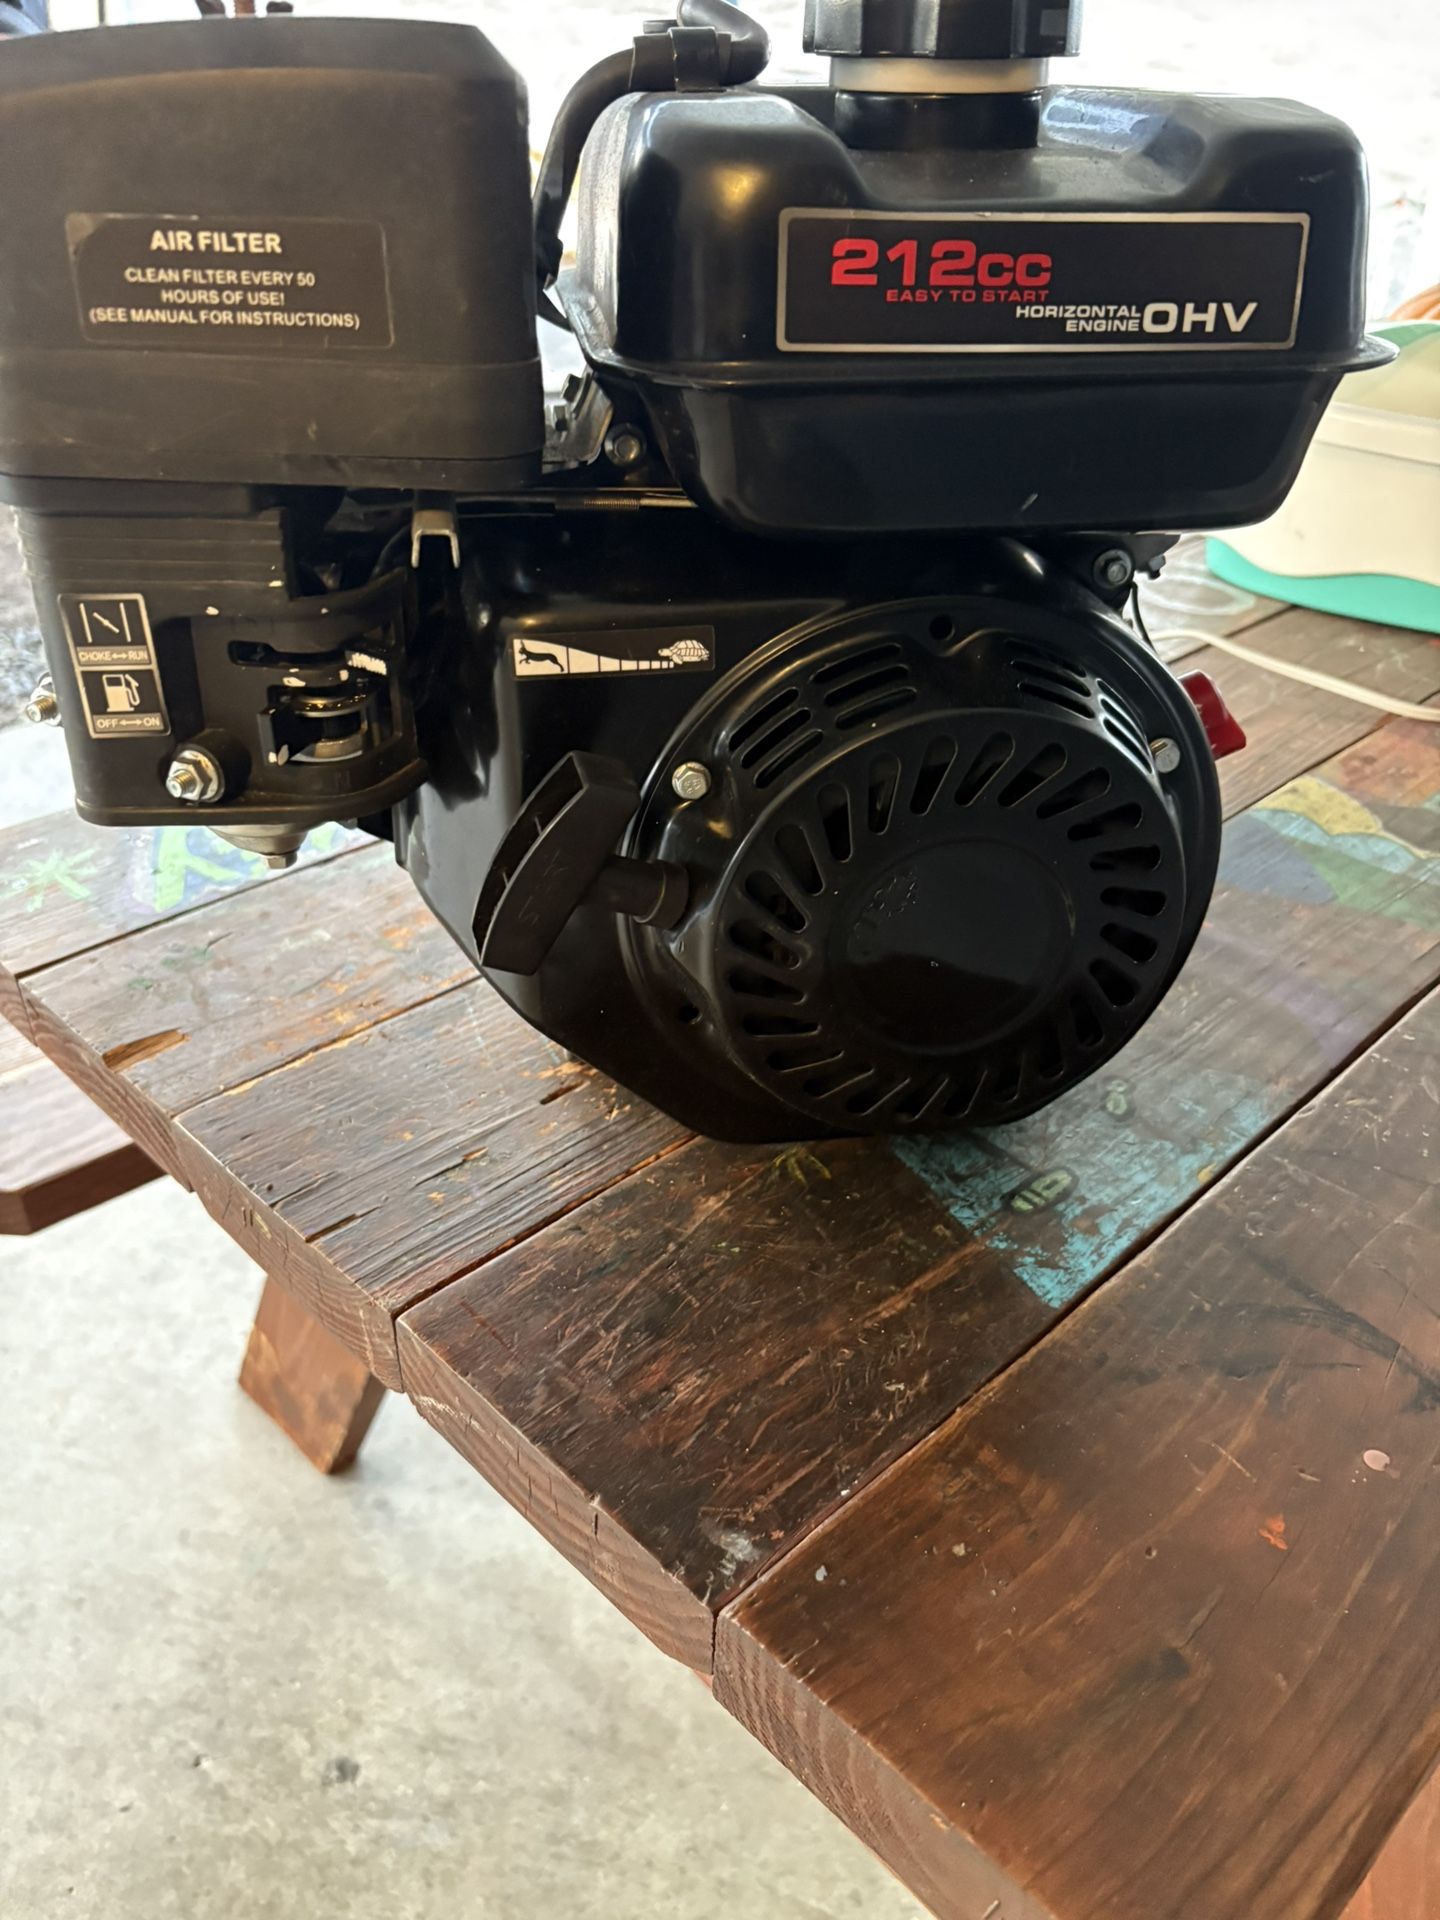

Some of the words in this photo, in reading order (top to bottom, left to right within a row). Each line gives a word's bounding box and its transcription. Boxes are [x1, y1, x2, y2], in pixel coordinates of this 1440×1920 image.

[151, 230, 193, 251] AIR
[198, 232, 282, 253] FILTER
[831, 238, 1052, 286] 212cc
[124, 267, 180, 284] CLEAN
[182, 269, 238, 285] FILTER
[241, 271, 293, 286] EVERY
[297, 272, 315, 286] 50
[161, 290, 220, 304] HOURS
[222, 291, 243, 305] OF
[248, 292, 285, 306] USE!
[886, 289, 942, 302] EASY
[949, 290, 977, 302] TO
[983, 290, 1049, 303] START
[89, 307, 127, 323] (SEE
[131, 308, 197, 324] MANUAL
[200, 310, 233, 325] FOR
[236, 311, 360, 330] INSTRUCTIONS)
[1016, 304, 1141, 318] HORIZONTAL
[1065, 318, 1139, 332] ENGINE
[1142, 302, 1258, 333] OHV
[79, 651, 112, 661] CHOKE
[128, 651, 148, 661] RUN
[96, 719, 118, 728] OFF
[143, 716, 160, 726] ON
